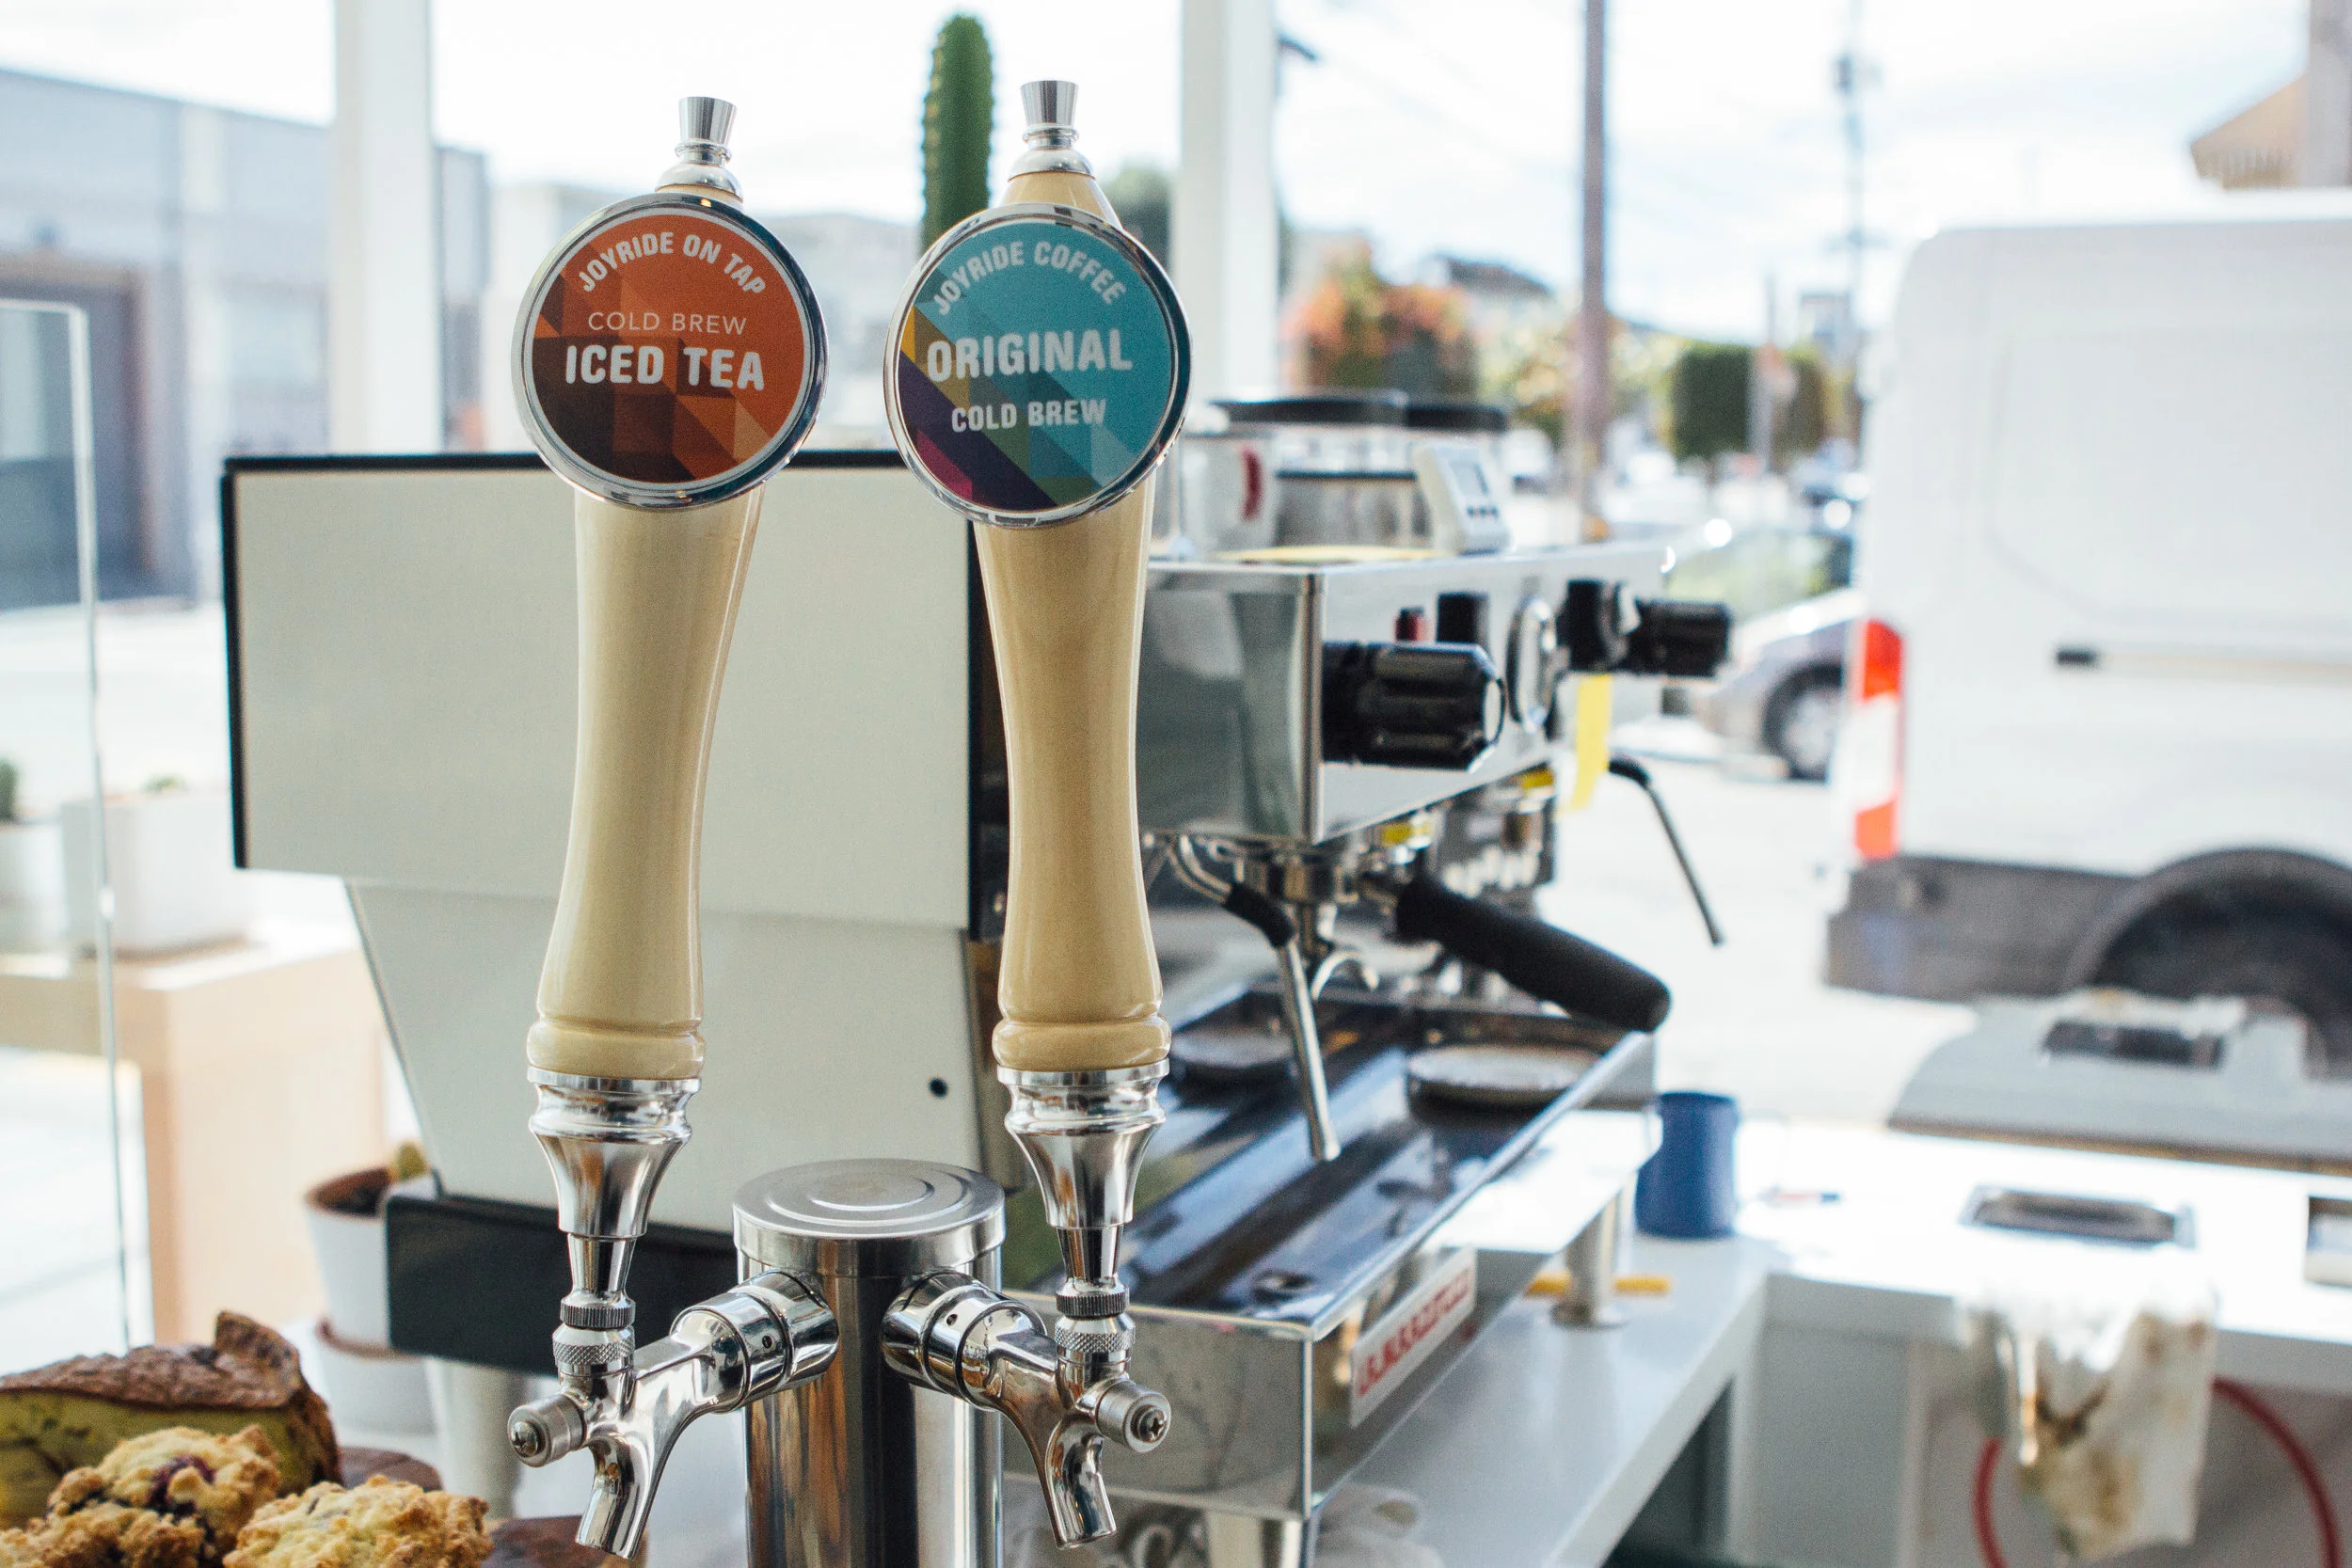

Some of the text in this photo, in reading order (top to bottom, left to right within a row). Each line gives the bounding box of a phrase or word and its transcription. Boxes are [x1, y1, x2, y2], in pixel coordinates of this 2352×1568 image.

[578, 231, 766, 294] JOYRIDE ON TAP
[933, 241, 1127, 316] JOYRIDE COFFEE
[588, 311, 747, 336] COLD BREW
[565, 344, 765, 391] ICED TEA
[927, 329, 1133, 383] ORIGINAL
[951, 398, 1106, 434] COLD BREW
